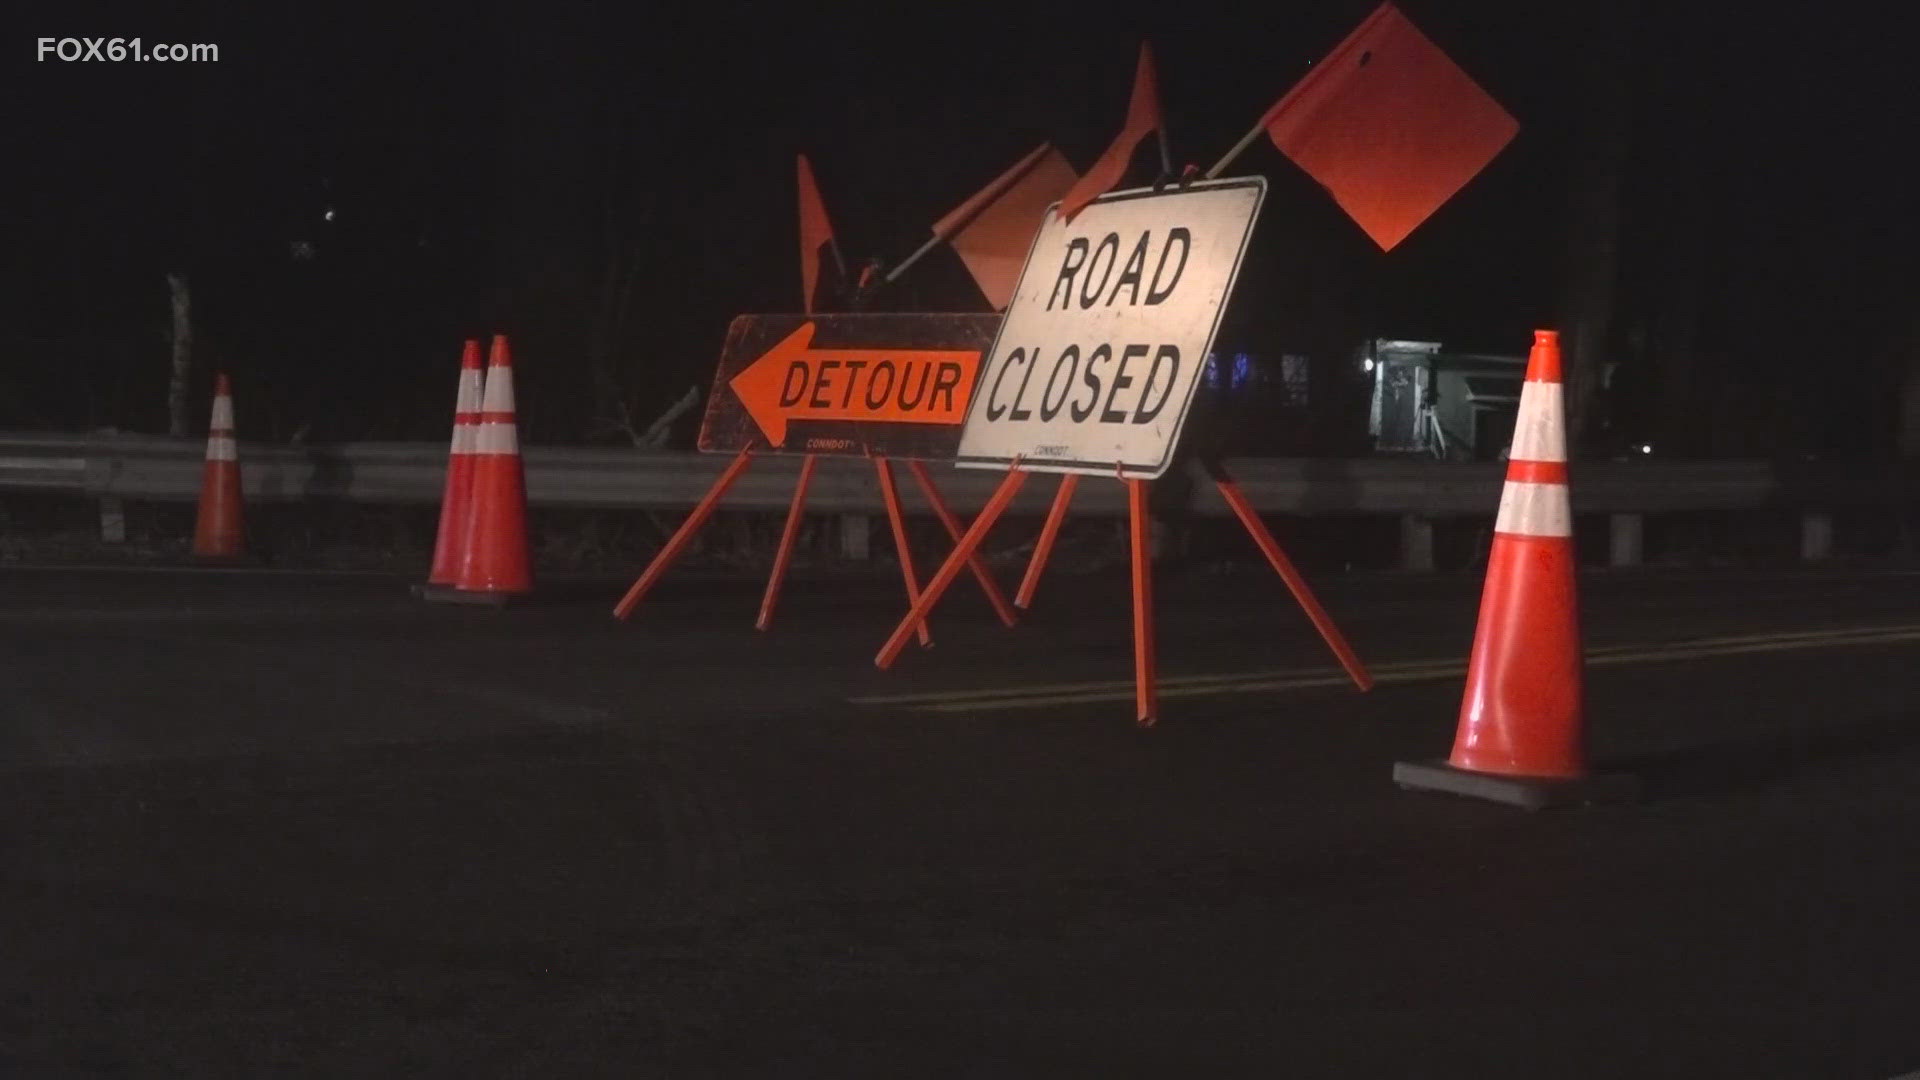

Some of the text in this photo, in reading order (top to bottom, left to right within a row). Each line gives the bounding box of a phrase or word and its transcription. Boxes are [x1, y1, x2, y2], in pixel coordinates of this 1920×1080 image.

[1047, 227, 1191, 311] ROAD
[779, 359, 962, 411] DETOUR
[986, 343, 1181, 424] CLOSED
